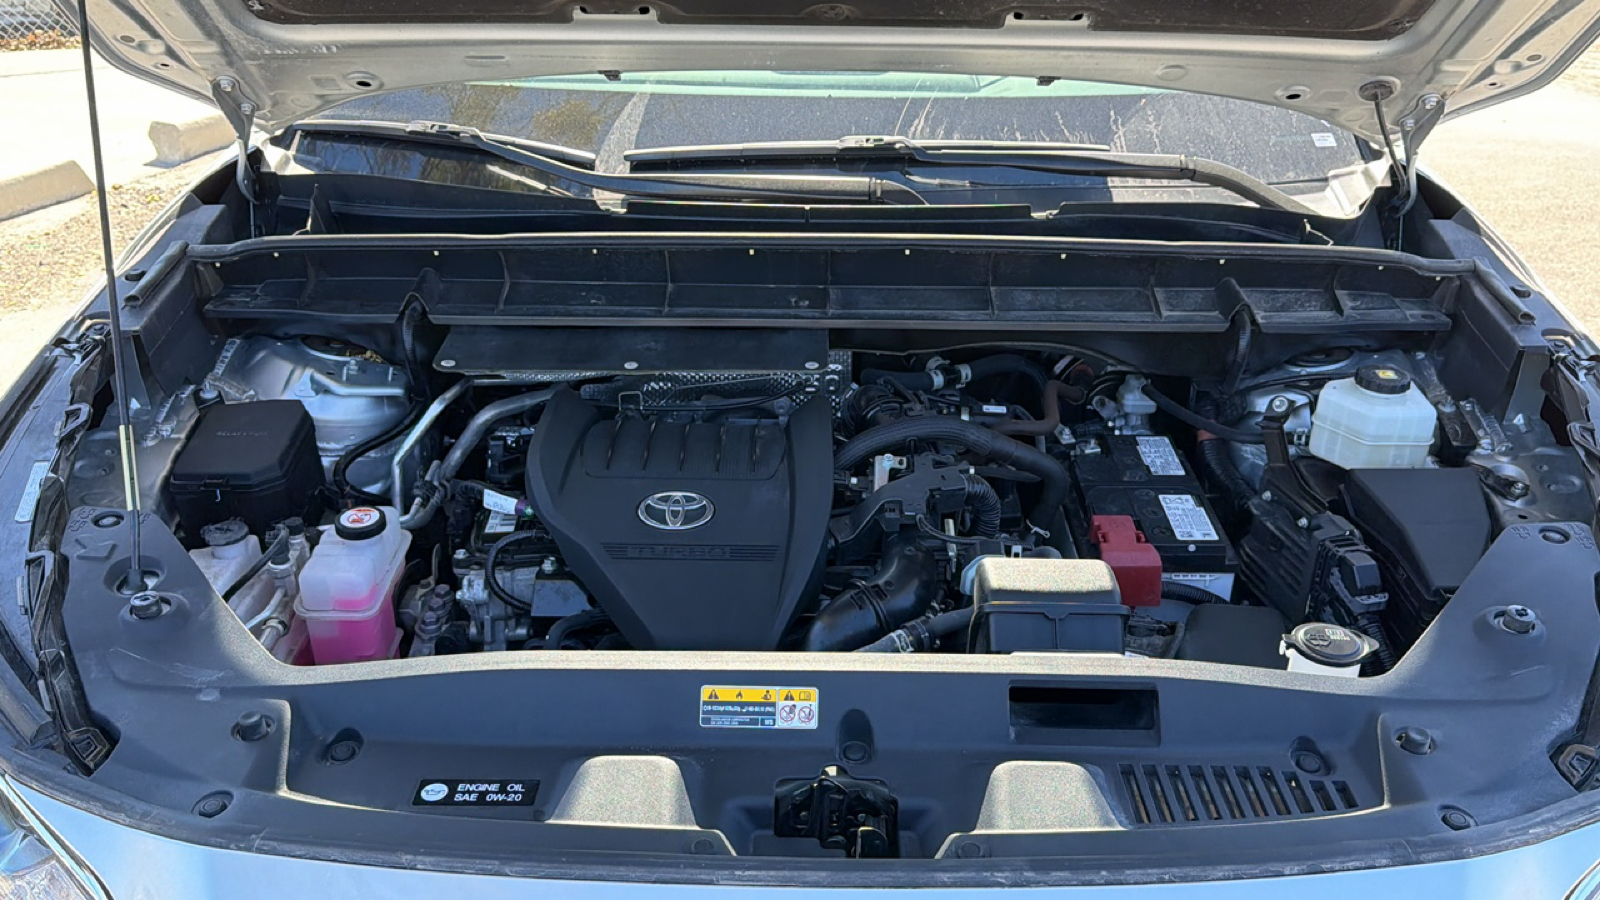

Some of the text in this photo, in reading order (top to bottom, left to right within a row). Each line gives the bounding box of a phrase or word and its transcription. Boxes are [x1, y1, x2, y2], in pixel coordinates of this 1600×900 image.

[457, 783, 525, 792] ENGINE OIL
[454, 793, 522, 801] SAE 0W-20
